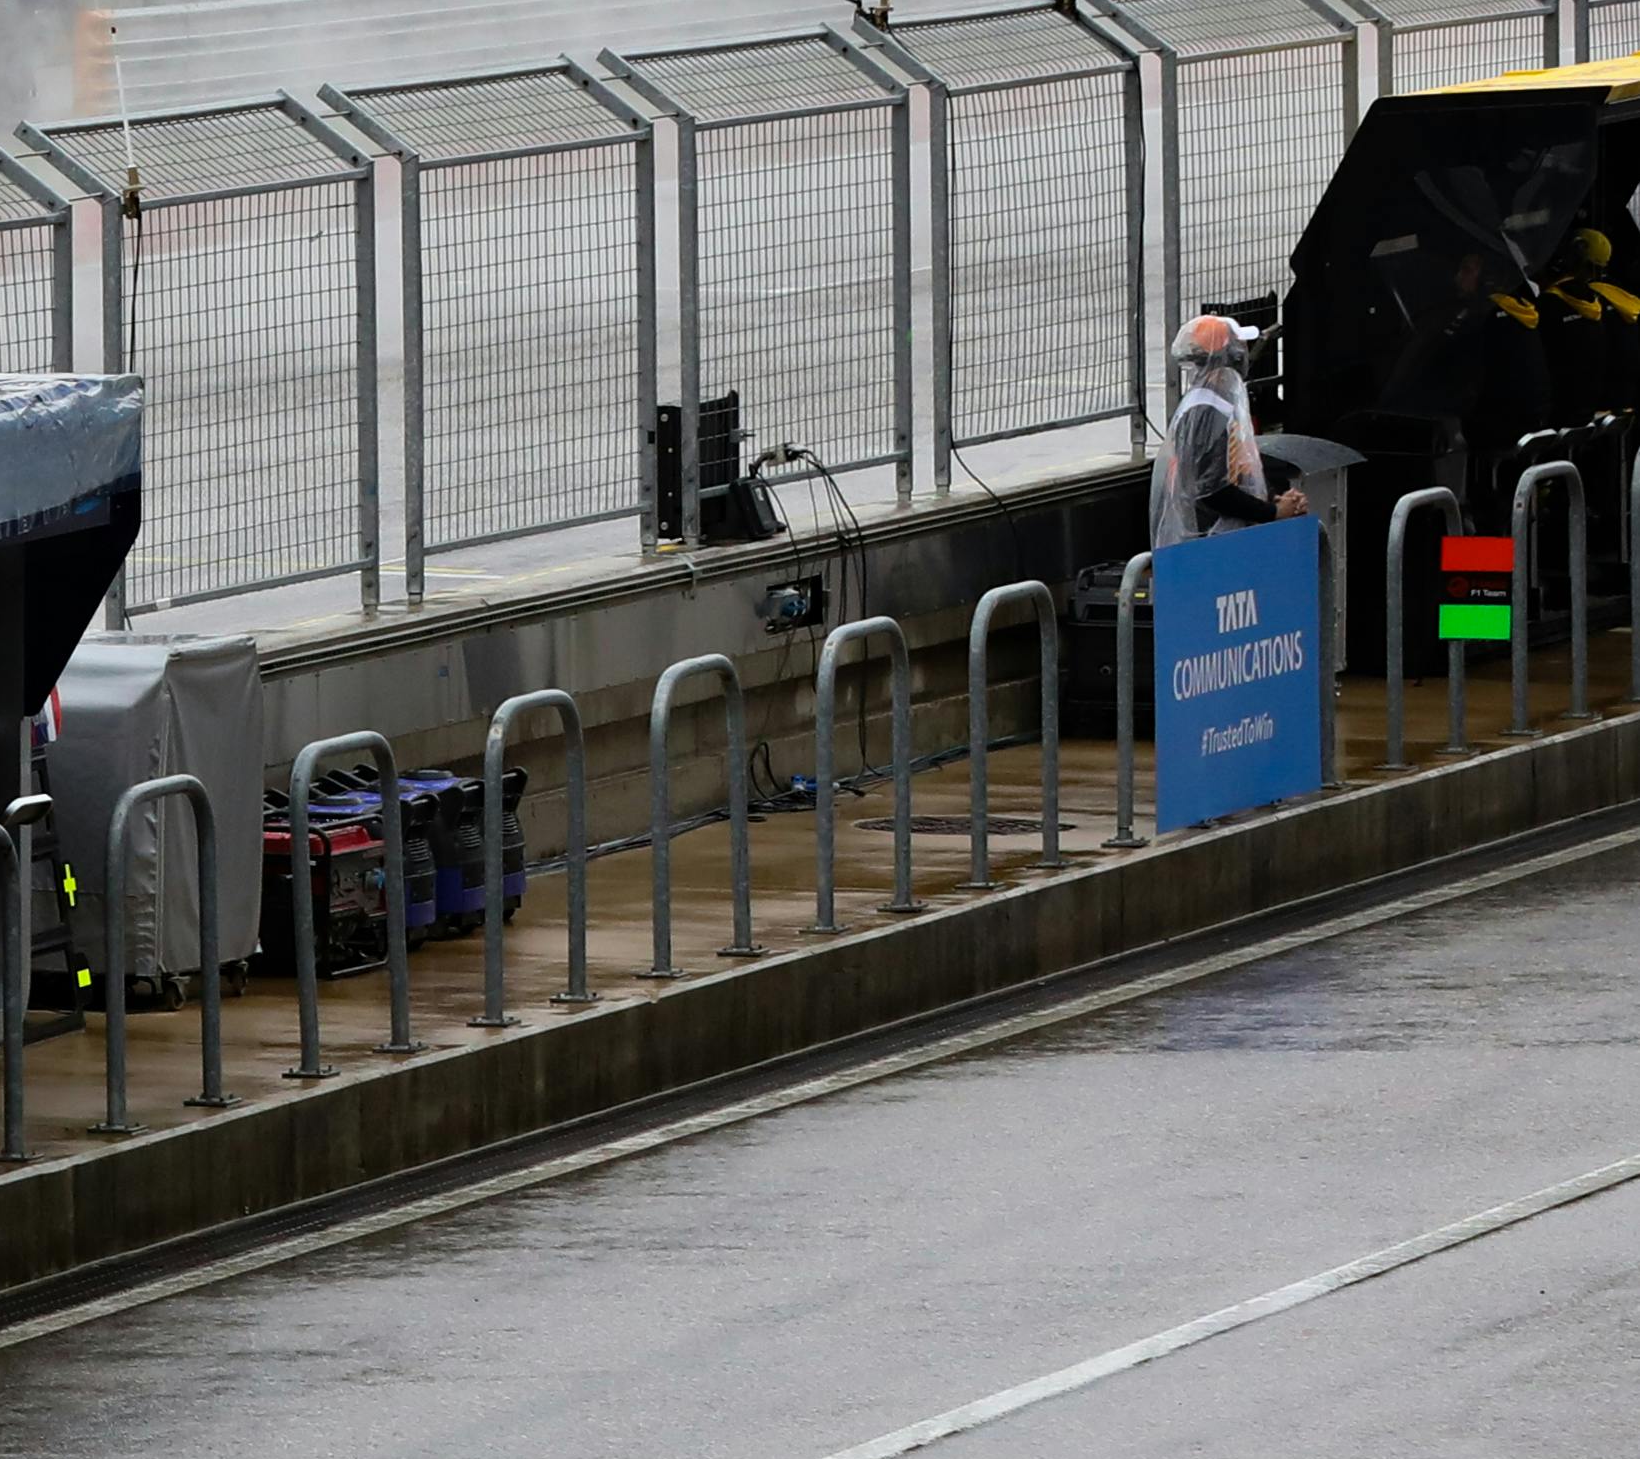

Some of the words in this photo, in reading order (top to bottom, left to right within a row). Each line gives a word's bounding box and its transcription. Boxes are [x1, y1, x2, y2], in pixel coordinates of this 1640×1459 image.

[1216, 589, 1258, 634] TATA
[1173, 629, 1303, 701] COMMUNICATIONS
[1201, 712, 1274, 757] #TrustedToWin
